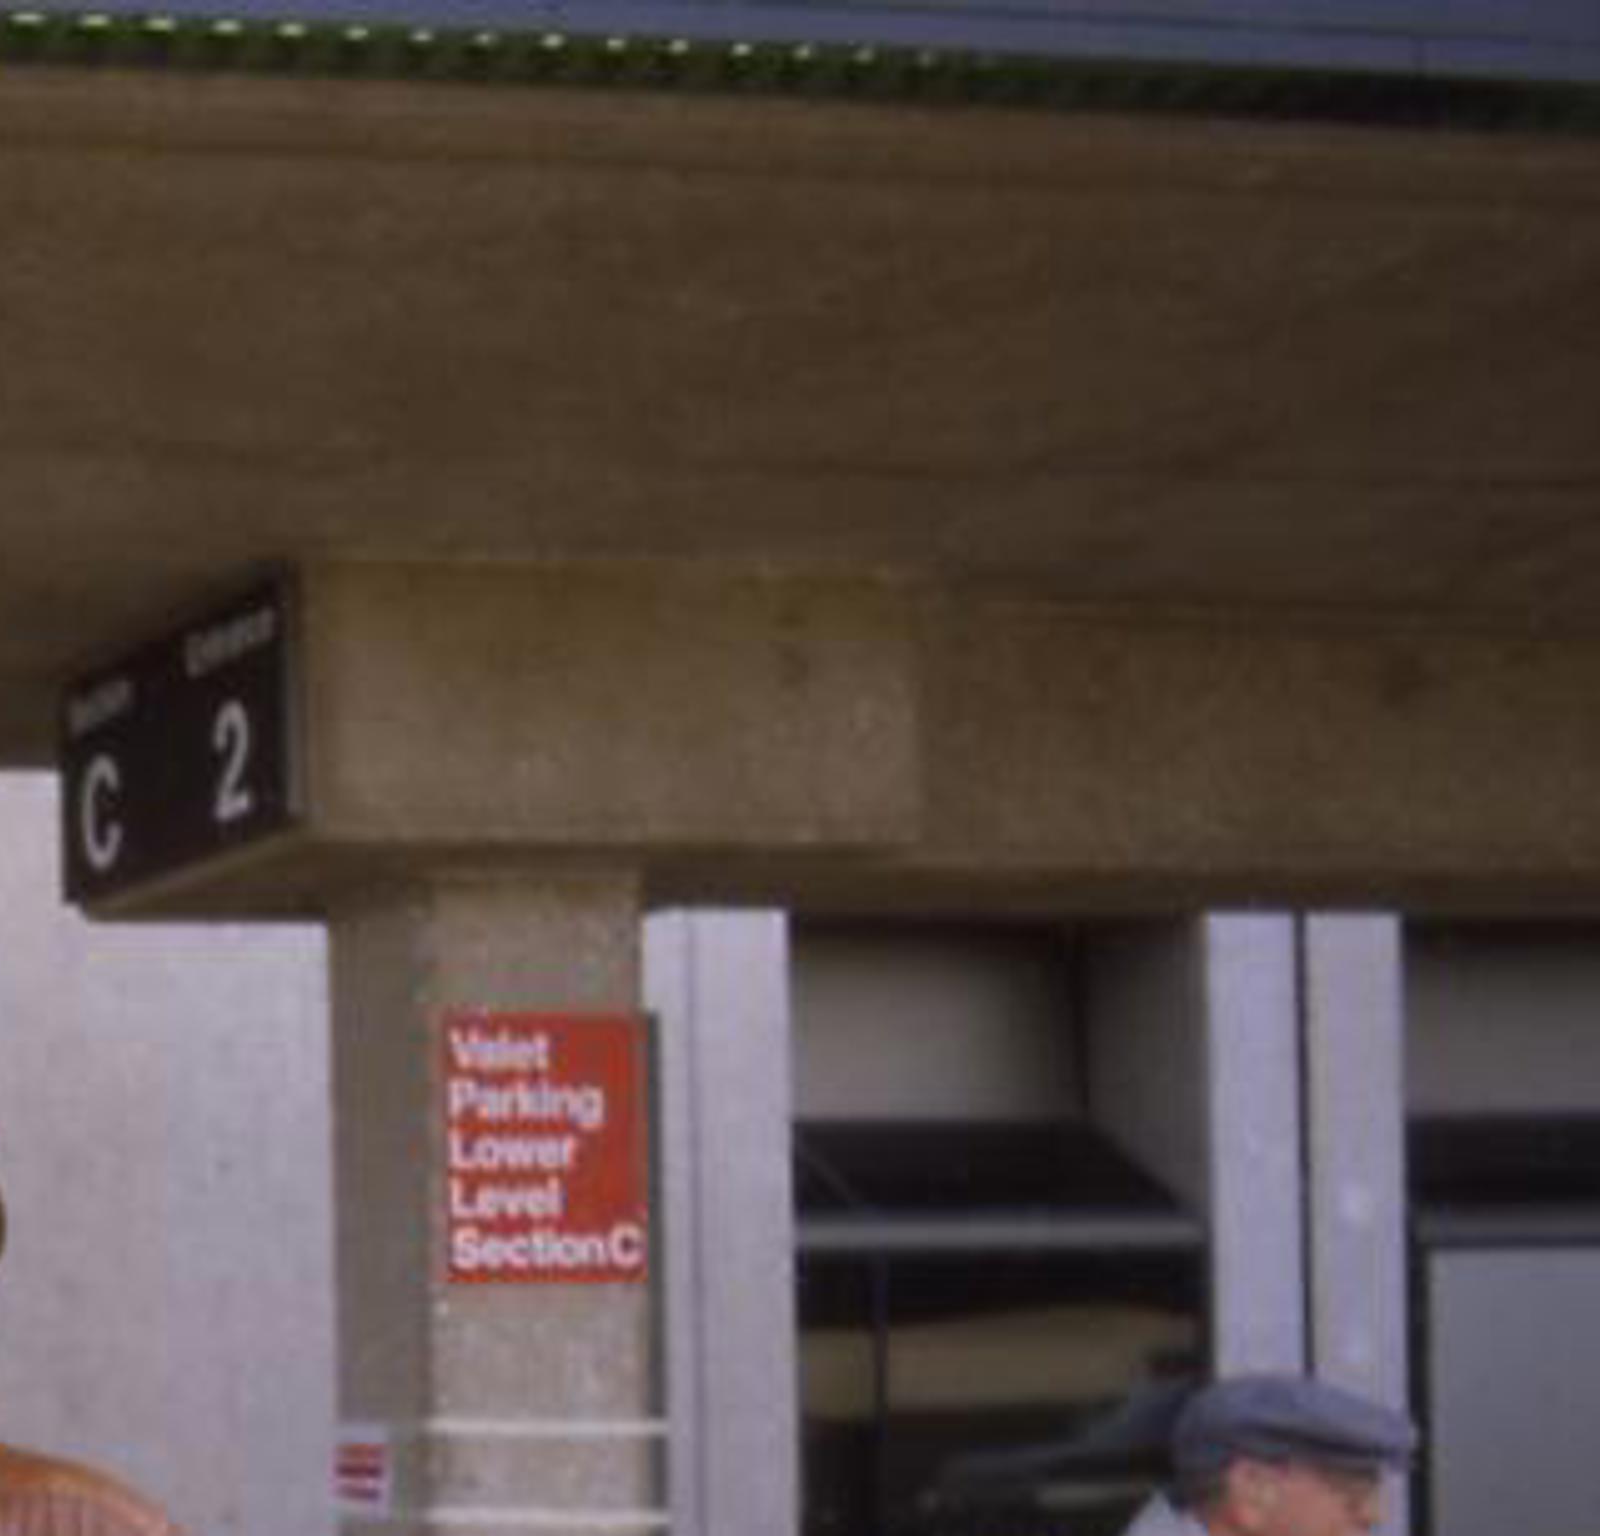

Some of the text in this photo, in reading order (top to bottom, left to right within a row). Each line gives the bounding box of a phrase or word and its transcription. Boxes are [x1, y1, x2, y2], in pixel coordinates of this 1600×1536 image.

[212, 700, 251, 822] 2
[81, 753, 124, 869] C
[449, 1029, 550, 1071] Valet
[448, 1079, 604, 1129] Parking
[448, 1131, 577, 1168] Lower
[448, 1178, 563, 1217] Level
[449, 1223, 643, 1270] Section C
